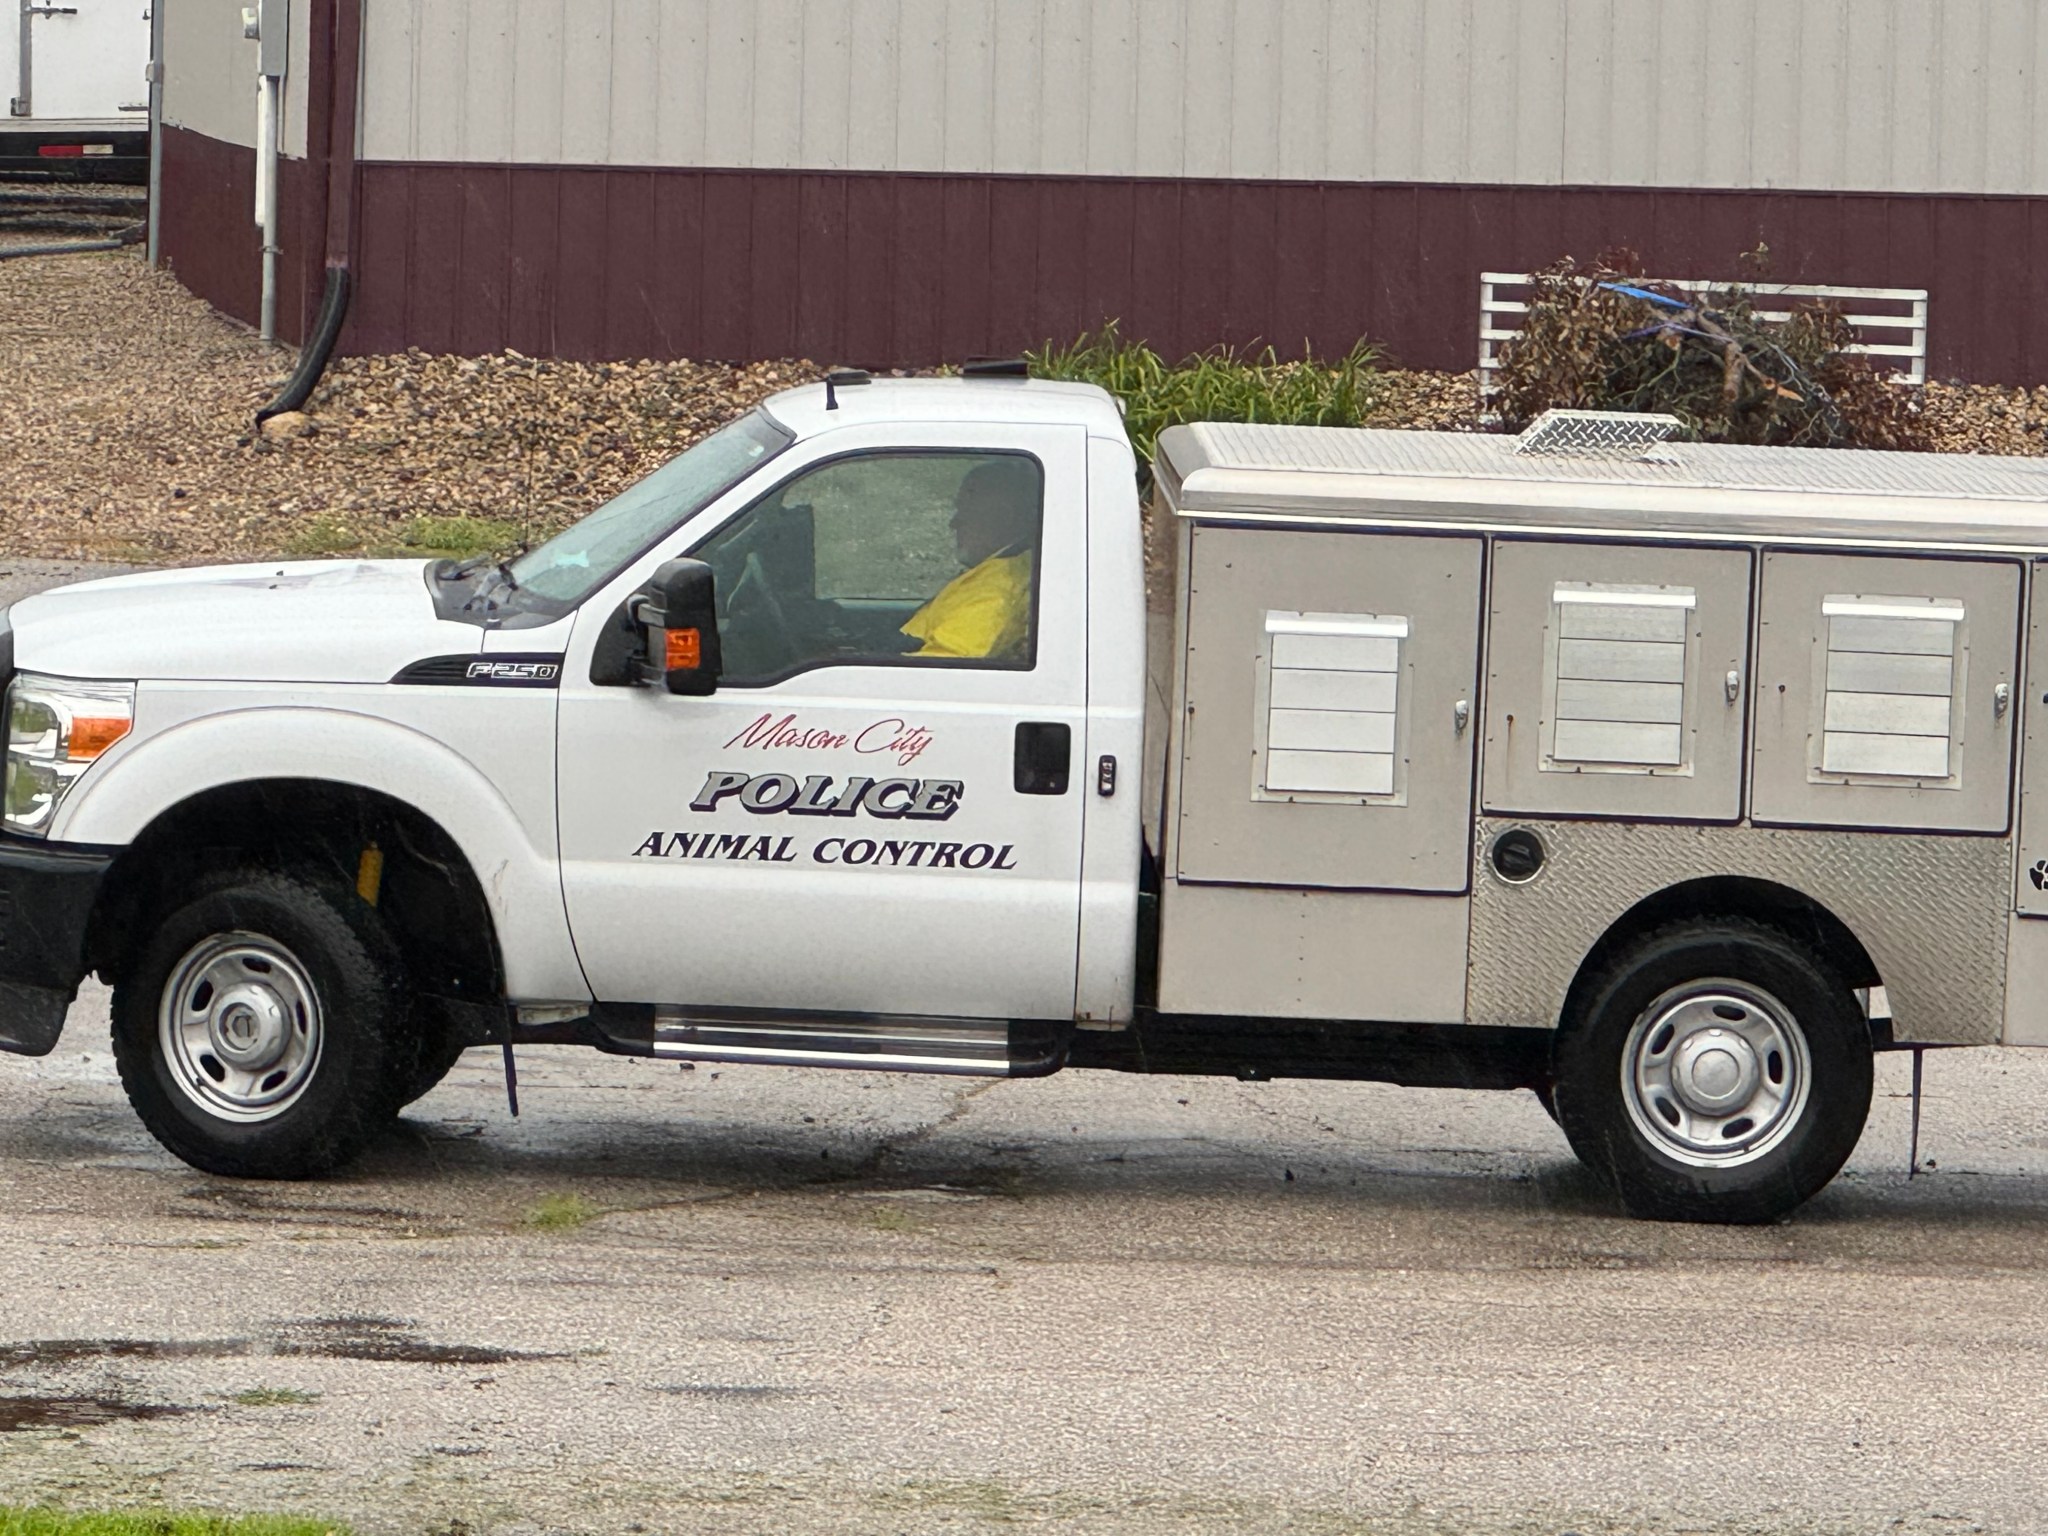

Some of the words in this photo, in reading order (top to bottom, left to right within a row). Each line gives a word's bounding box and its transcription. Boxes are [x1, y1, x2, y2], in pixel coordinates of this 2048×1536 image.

[723, 713, 850, 750] Mason
[855, 718, 933, 766] City
[690, 771, 964, 820] POLICE
[632, 831, 797, 861] ANIMAL
[812, 838, 1018, 870] CONTROL
